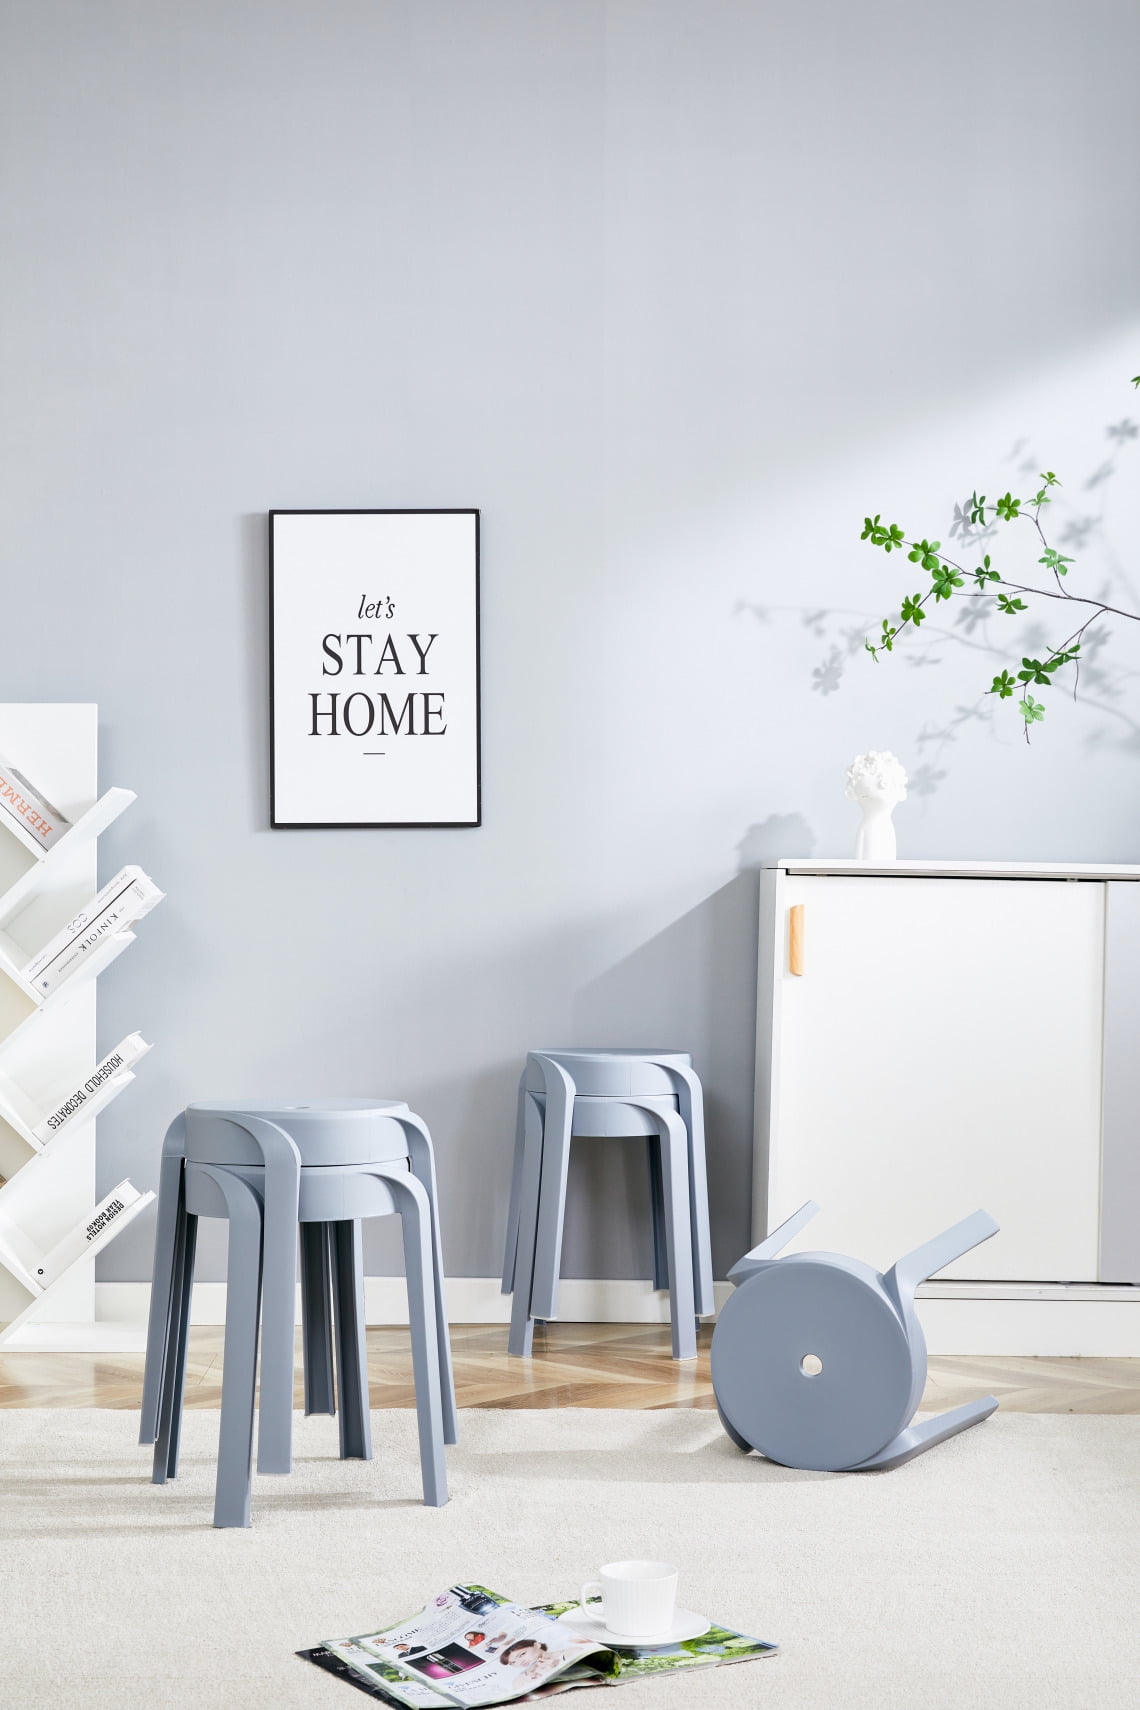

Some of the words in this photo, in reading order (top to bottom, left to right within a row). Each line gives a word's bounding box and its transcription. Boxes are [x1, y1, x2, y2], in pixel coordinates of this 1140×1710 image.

[322, 632, 439, 676] STAY
[307, 692, 448, 736] HOME
[66, 913, 88, 934] COS
[78, 912, 119, 952] KINFOLK
[84, 1053, 124, 1093] HOUSEHOLD
[47, 1090, 87, 1130] DECORATES
[104, 1202, 125, 1223] DESIGN
[105, 1199, 121, 1213] YEAR
[86, 1220, 107, 1241] HOTELS
